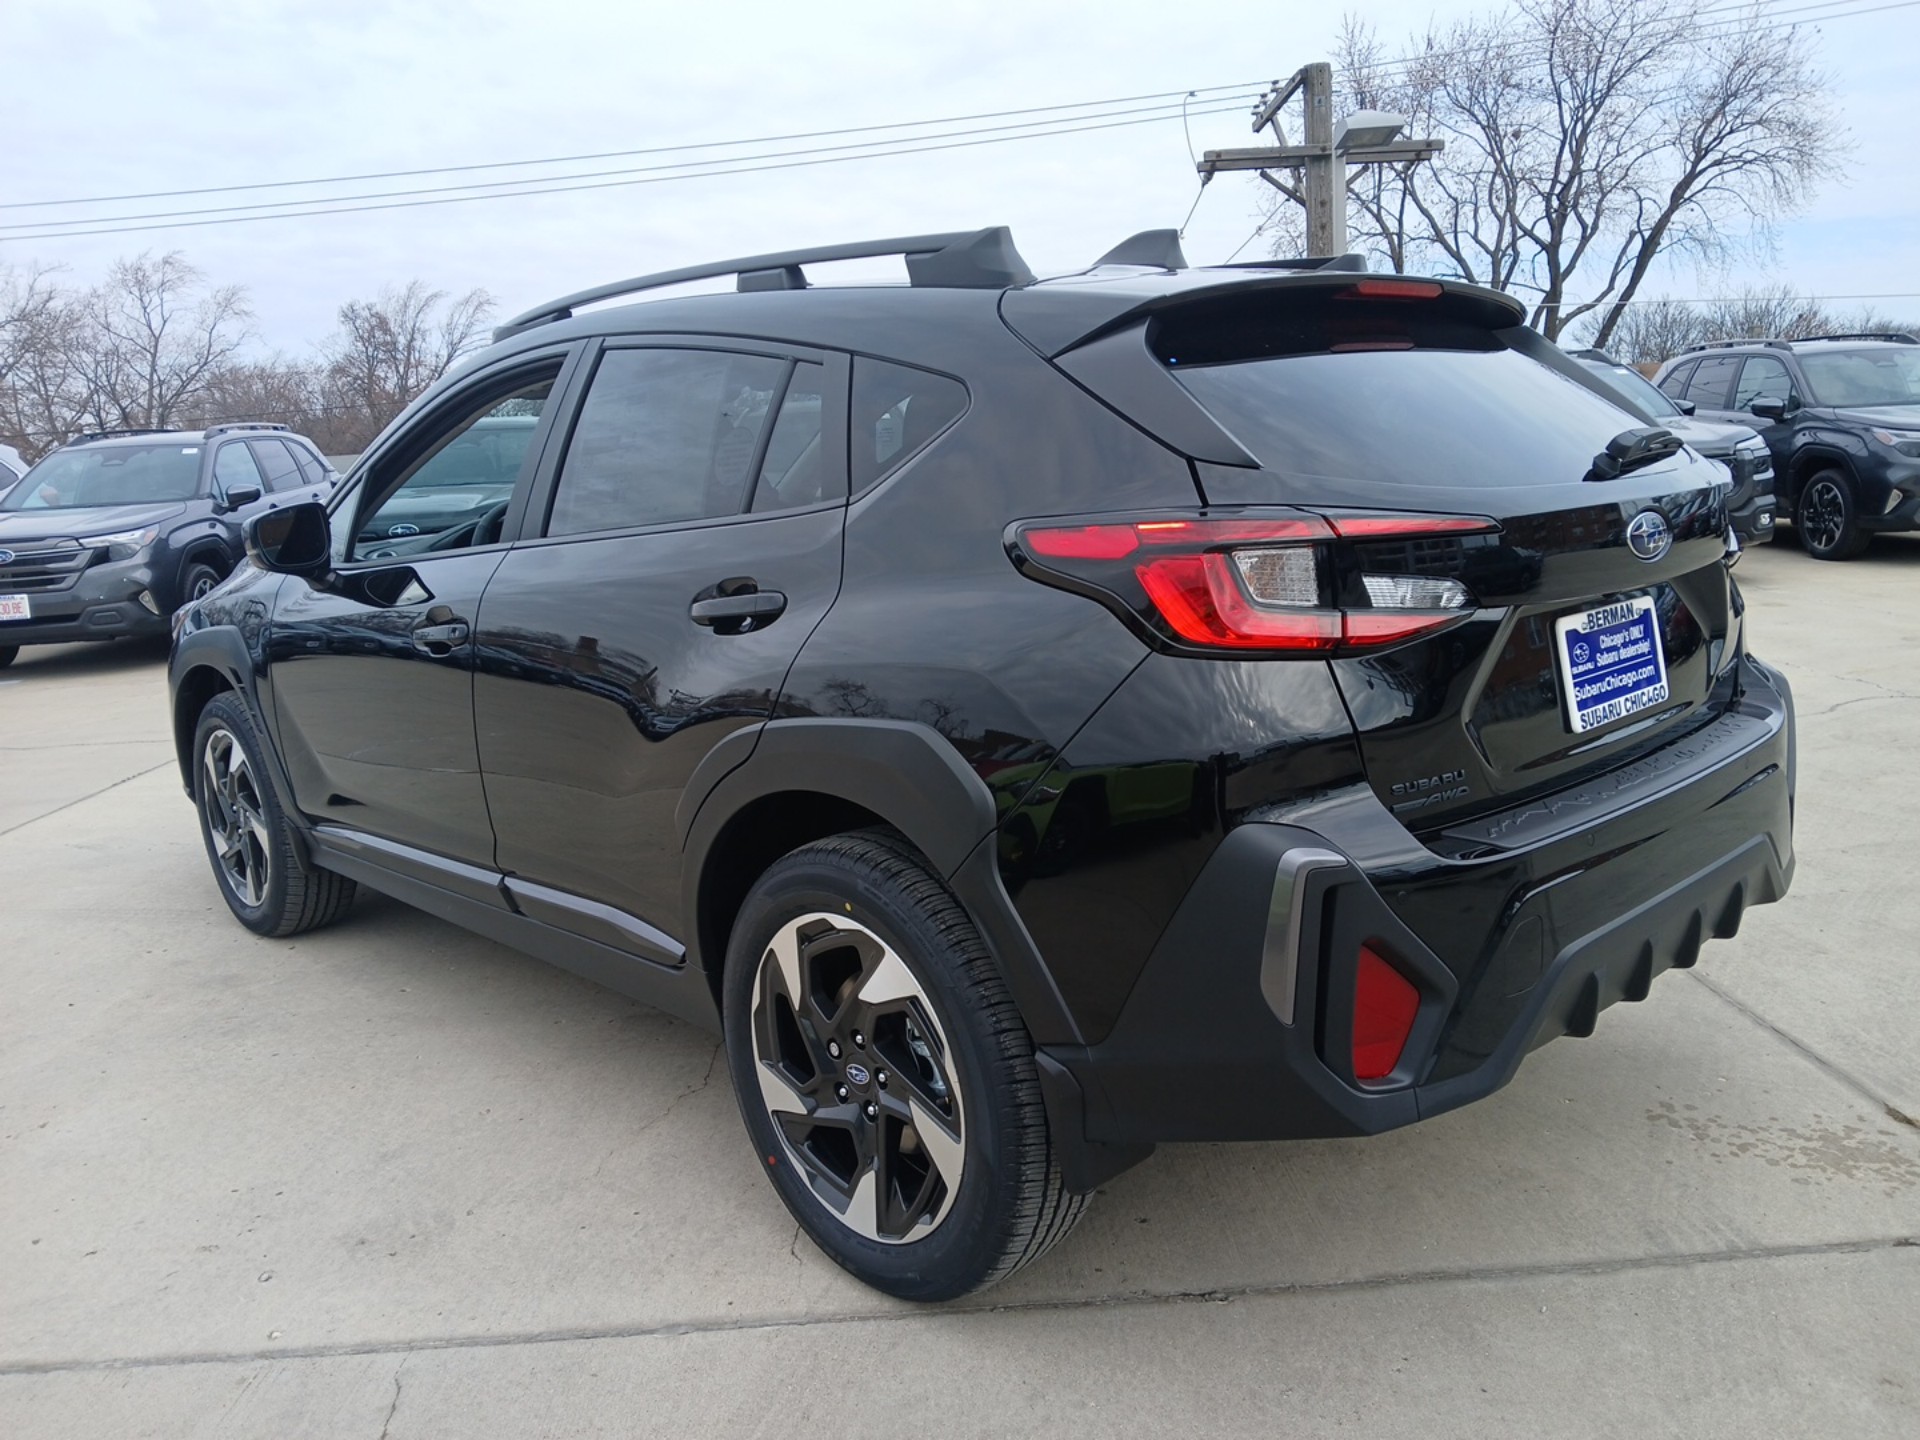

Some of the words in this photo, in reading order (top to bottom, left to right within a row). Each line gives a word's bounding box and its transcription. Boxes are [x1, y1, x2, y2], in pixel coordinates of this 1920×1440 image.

[1587, 602, 1634, 630] BERMAN
[1599, 628, 1629, 649] Chicago's
[1630, 624, 1644, 640] ONLY
[1596, 650, 1619, 667] Subaru
[1575, 665, 1655, 701] SubaruChicago.com
[1580, 704, 1622, 729] SUBARU
[1624, 685, 1666, 713] CHICAGO
[1391, 769, 1464, 795] SUBARU
[1423, 785, 1470, 807] AWD
